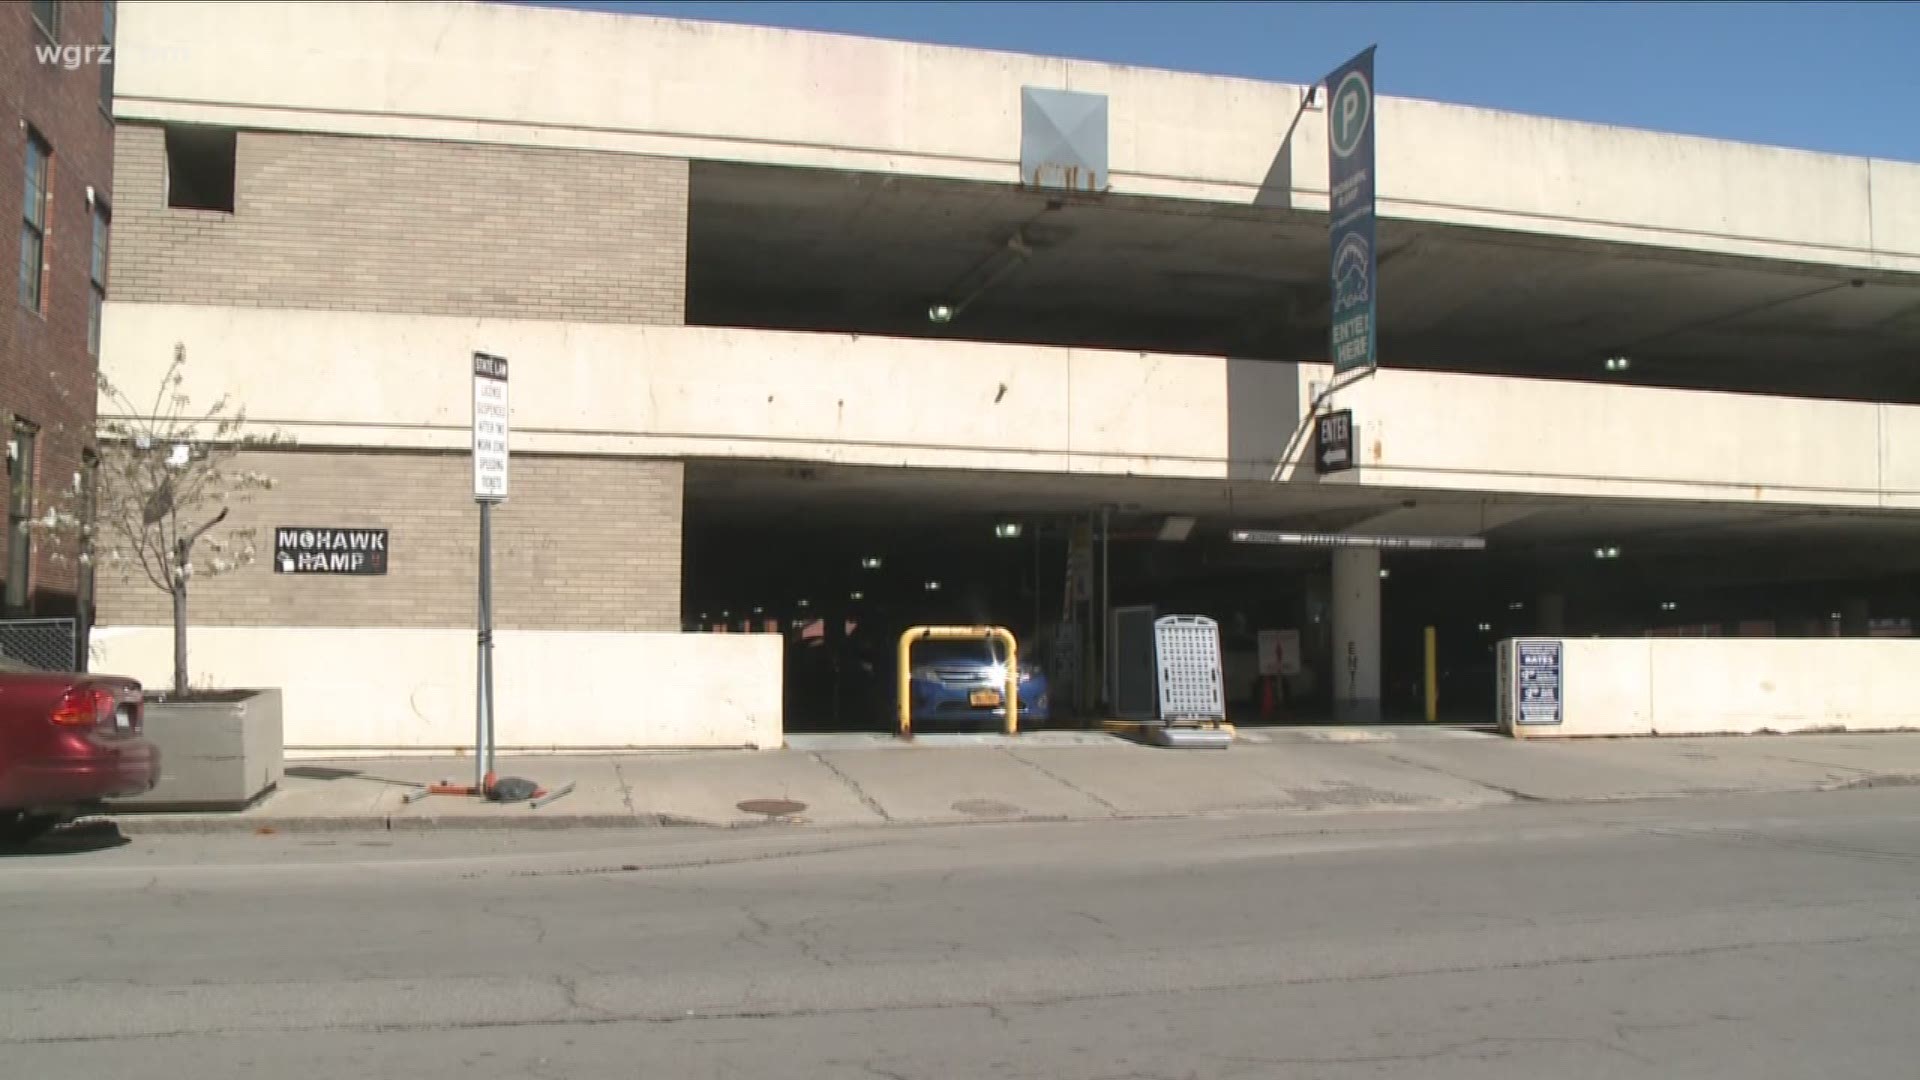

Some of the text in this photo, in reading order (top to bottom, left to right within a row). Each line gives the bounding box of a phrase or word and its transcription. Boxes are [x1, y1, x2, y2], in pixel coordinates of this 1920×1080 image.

[1342, 90, 1359, 142] P
[1338, 336, 1368, 364] HERE
[1320, 415, 1349, 443] ENTER
[279, 530, 384, 551] MOHAWK
[298, 552, 365, 571] RAMP
[1524, 654, 1554, 666] RATES
